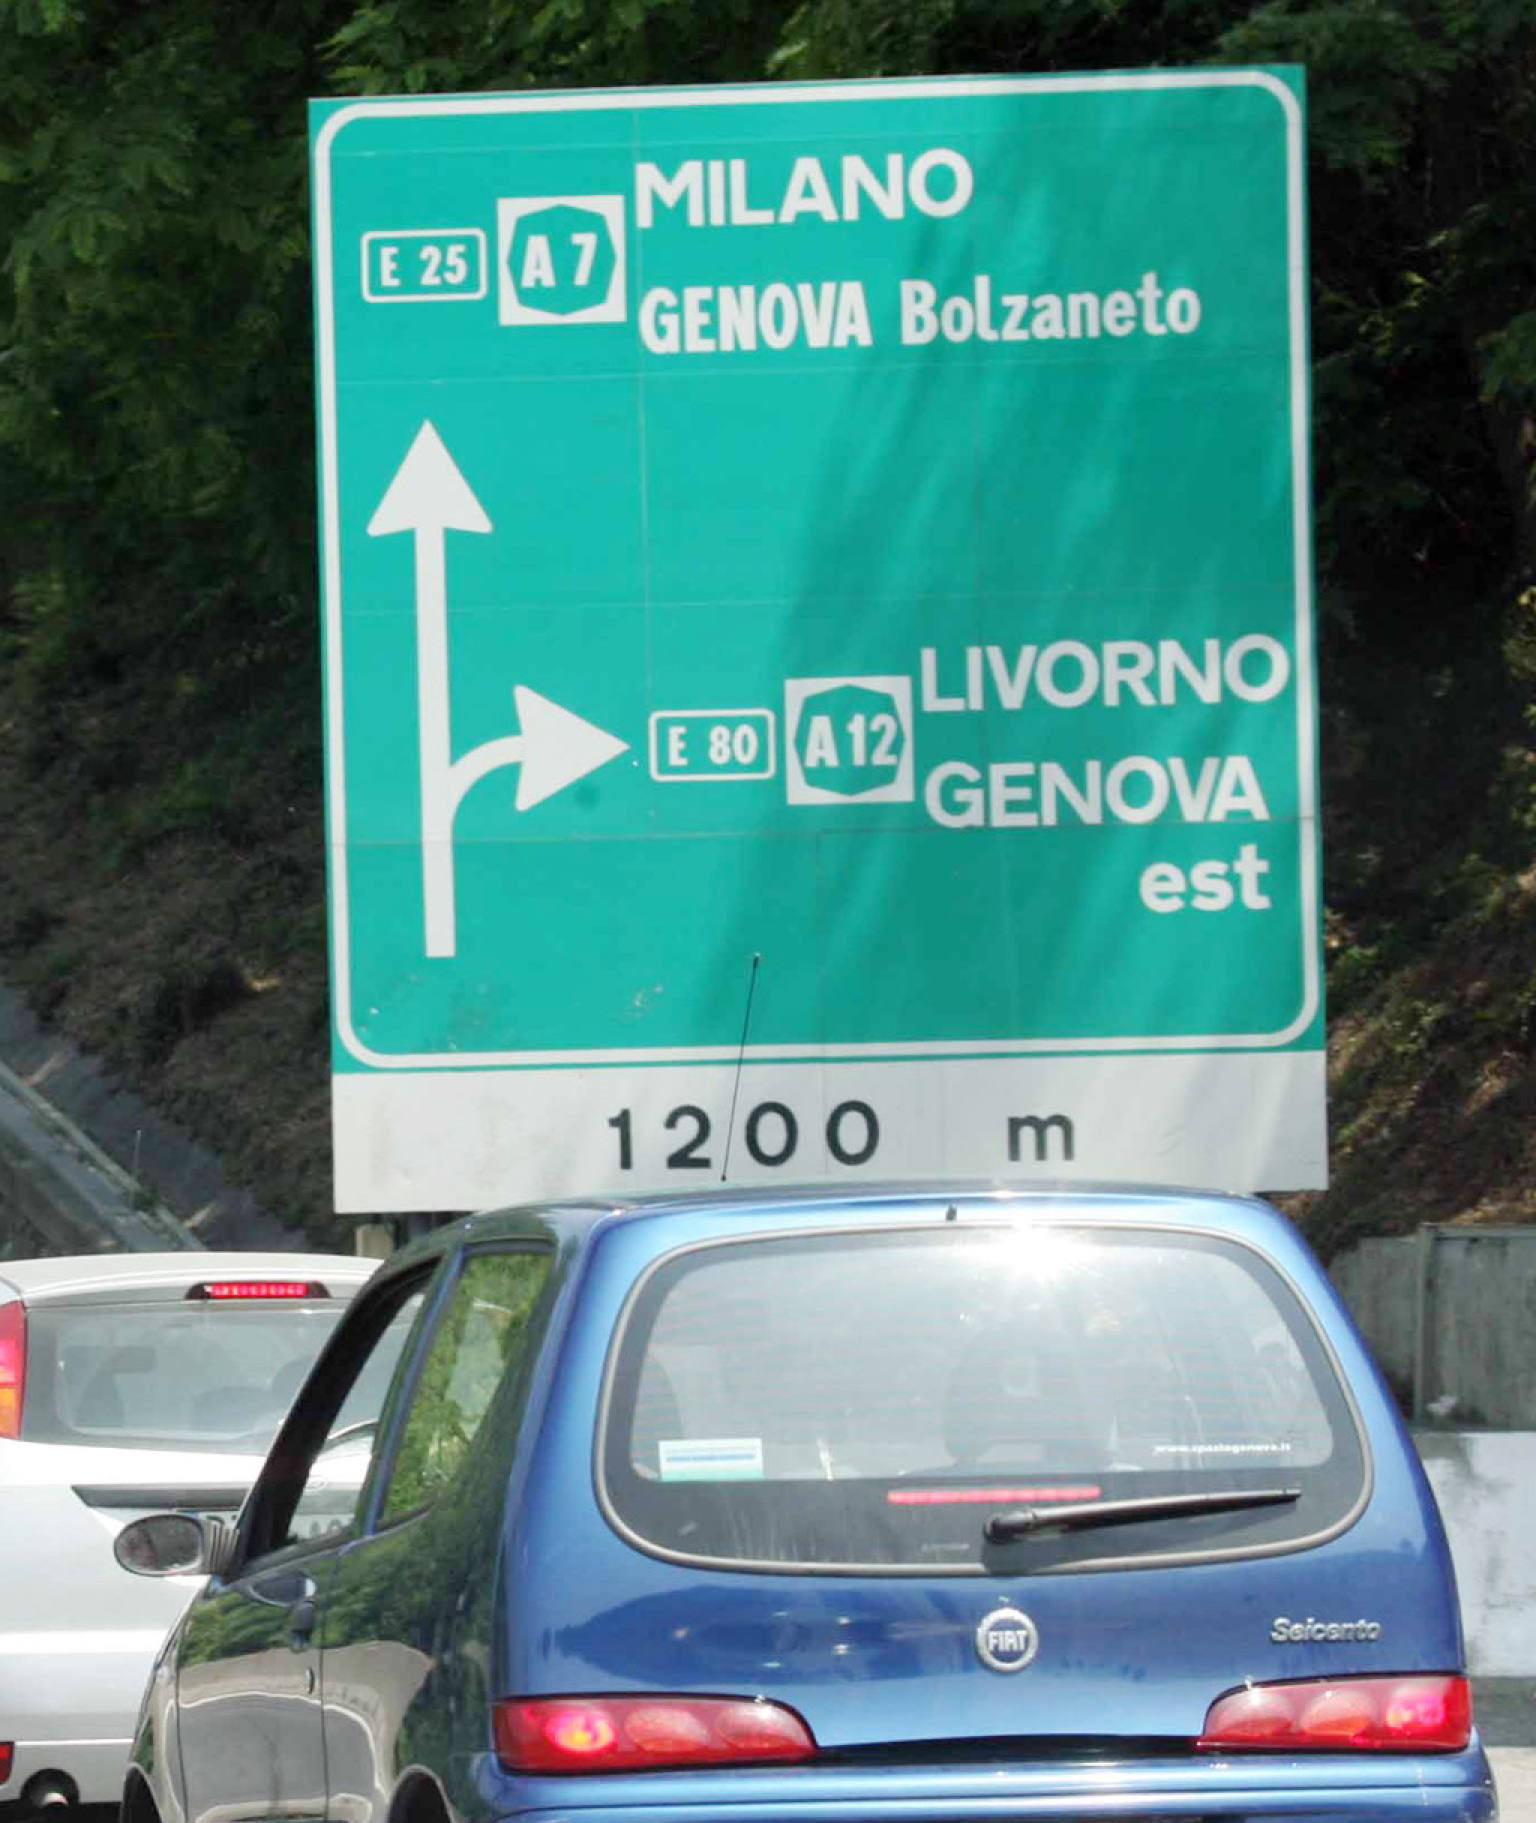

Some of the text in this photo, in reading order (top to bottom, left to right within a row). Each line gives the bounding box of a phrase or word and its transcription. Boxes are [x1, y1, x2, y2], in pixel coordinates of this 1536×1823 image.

[636, 148, 974, 229] MILANO
[380, 244, 468, 287] E 25
[638, 272, 1201, 355] GENOVA Bolzaneto
[921, 634, 1290, 712] LIVORNO
[668, 723, 759, 767] E 80
[925, 755, 1270, 828] GENOVA
[1139, 844, 1271, 913] est
[608, 1100, 1074, 1170] 1200 m
[988, 1630, 1027, 1652] FIAT
